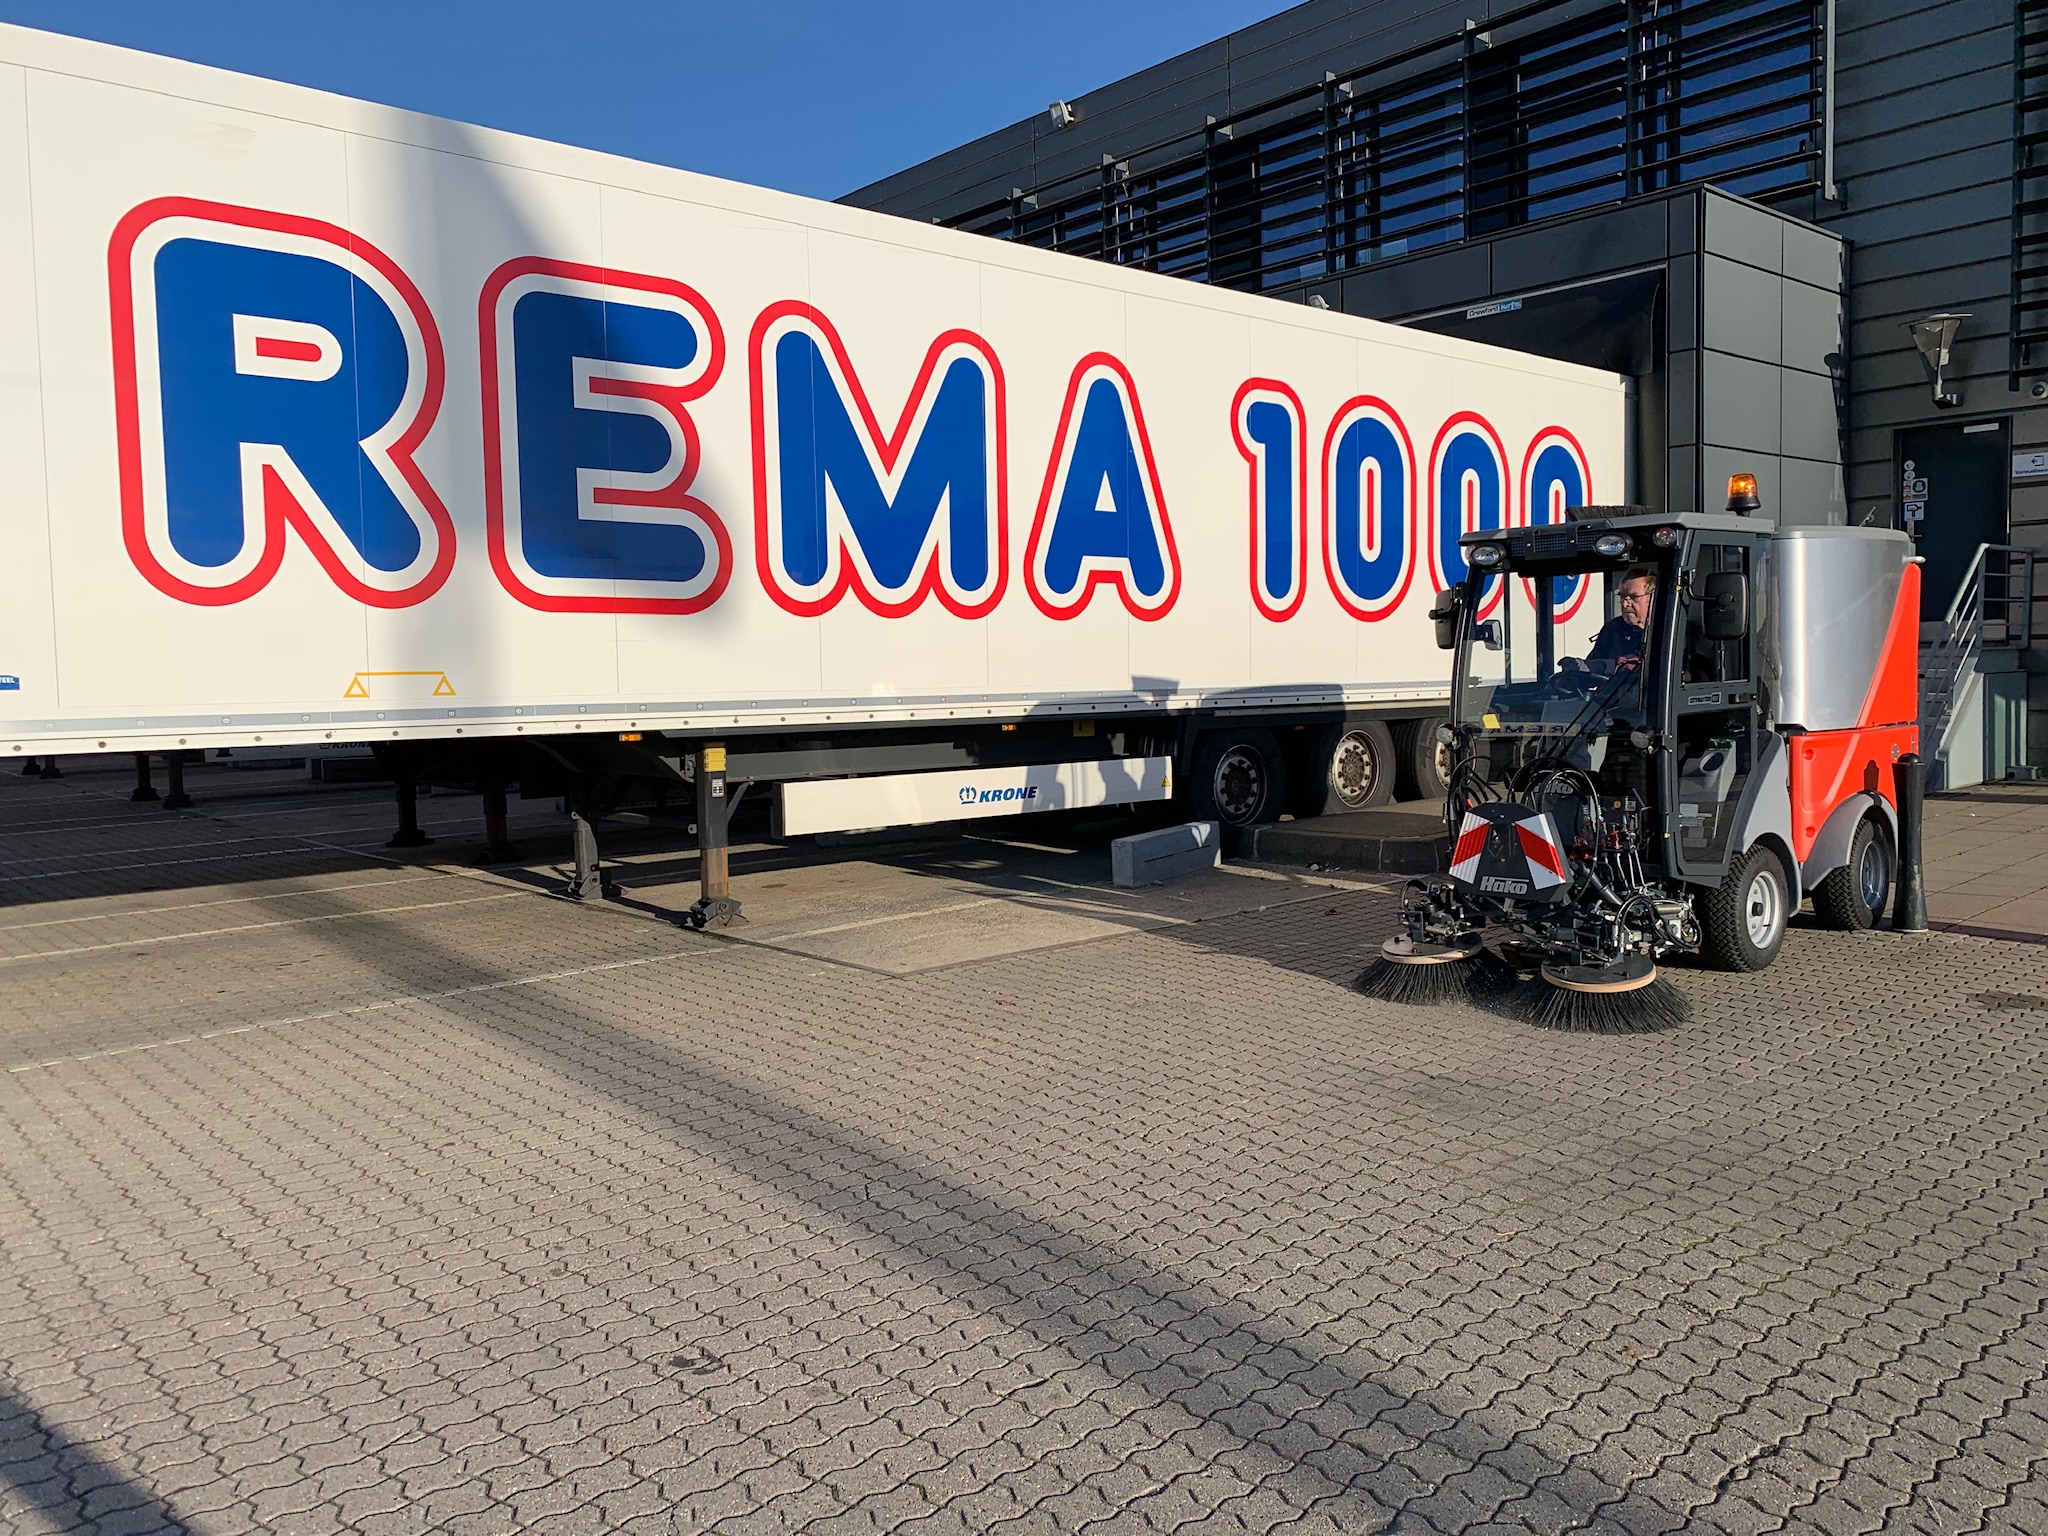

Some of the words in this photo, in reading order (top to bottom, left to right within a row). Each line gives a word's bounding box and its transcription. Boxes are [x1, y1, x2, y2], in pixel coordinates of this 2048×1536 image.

[108, 195, 1182, 622] REMA
[1230, 376, 1593, 624] 1000
[978, 786, 1038, 803] KRONE
[1480, 876, 1530, 895] Hako
